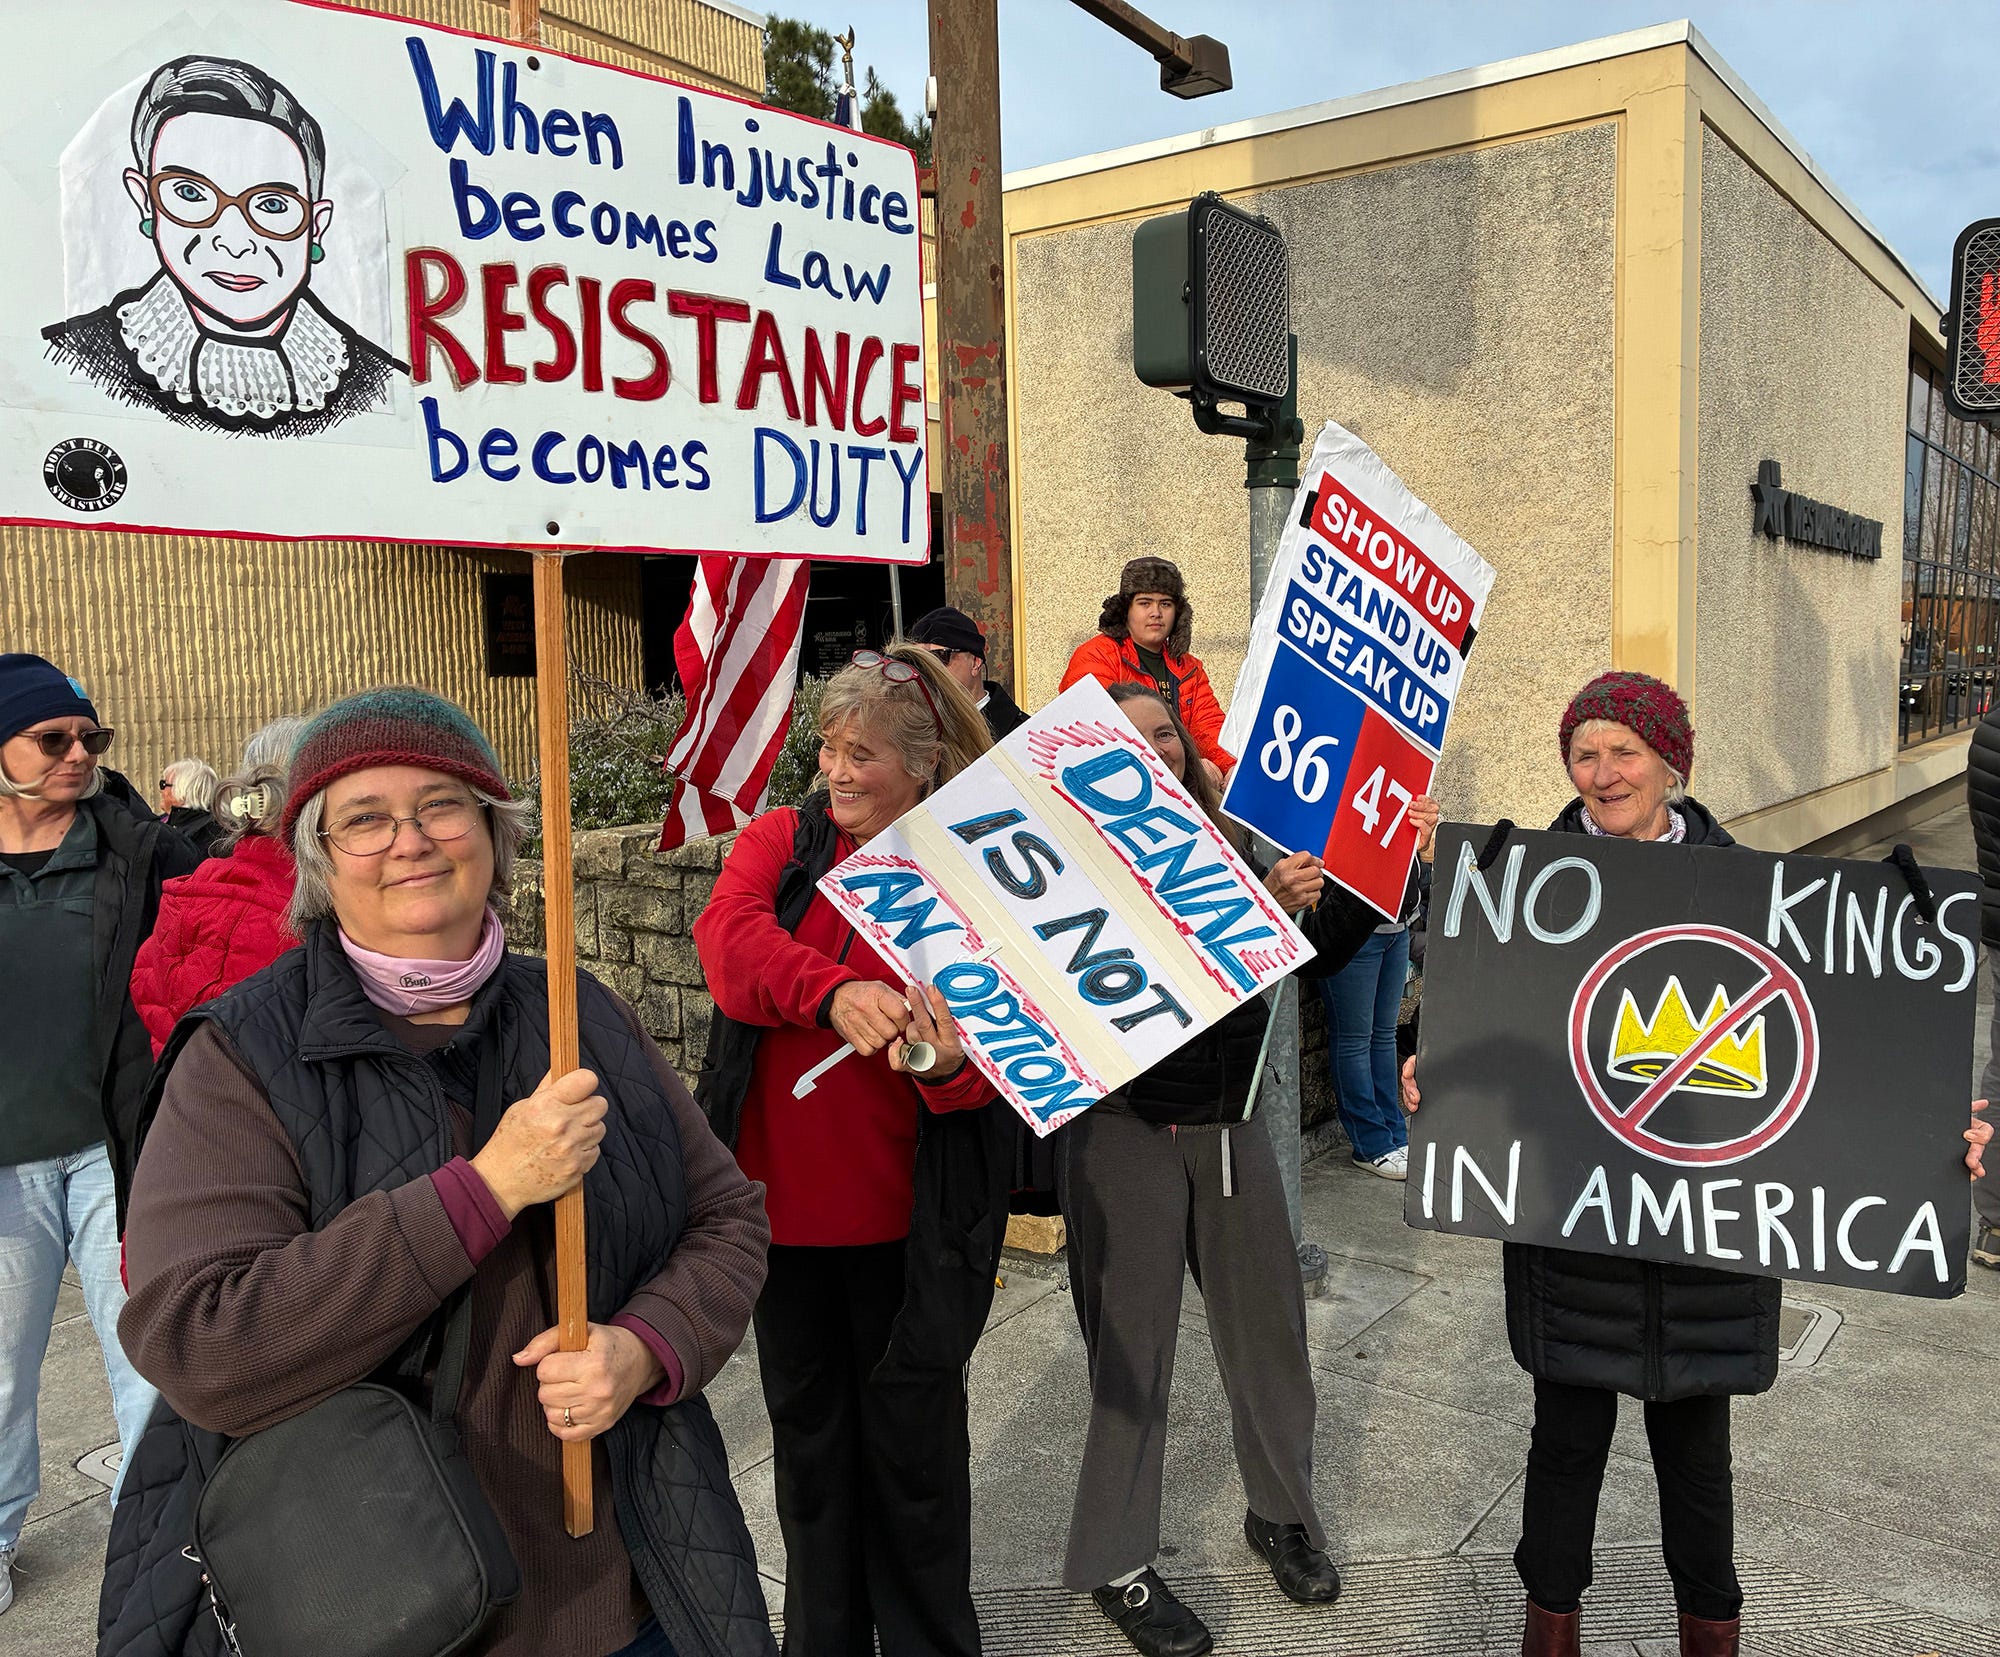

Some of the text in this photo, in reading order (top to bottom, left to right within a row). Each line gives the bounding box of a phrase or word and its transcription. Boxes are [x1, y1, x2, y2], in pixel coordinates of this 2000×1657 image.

[406, 37, 915, 235] When Injustice
[449, 158, 892, 304] becomes Law
[405, 247, 922, 443] RESISTANCE
[44, 439, 123, 474] DON'T BUY A
[49, 481, 126, 511] SWASTICAR
[419, 397, 924, 544] becomes DUTY
[1301, 543, 1451, 679] STAND UP
[1322, 492, 1463, 627] SHOW UP
[1287, 598, 1440, 729] SPEAK UP
[1260, 704, 1413, 850] 86 47
[947, 808, 1193, 1034] IS NOT
[1061, 747, 1277, 994] DENIAL
[1444, 840, 1977, 994] NO KINGS
[404, 977, 429, 988] Buff
[840, 872, 1101, 1124] AN OPTION
[1421, 1140, 1948, 1284] IN AMERICA
